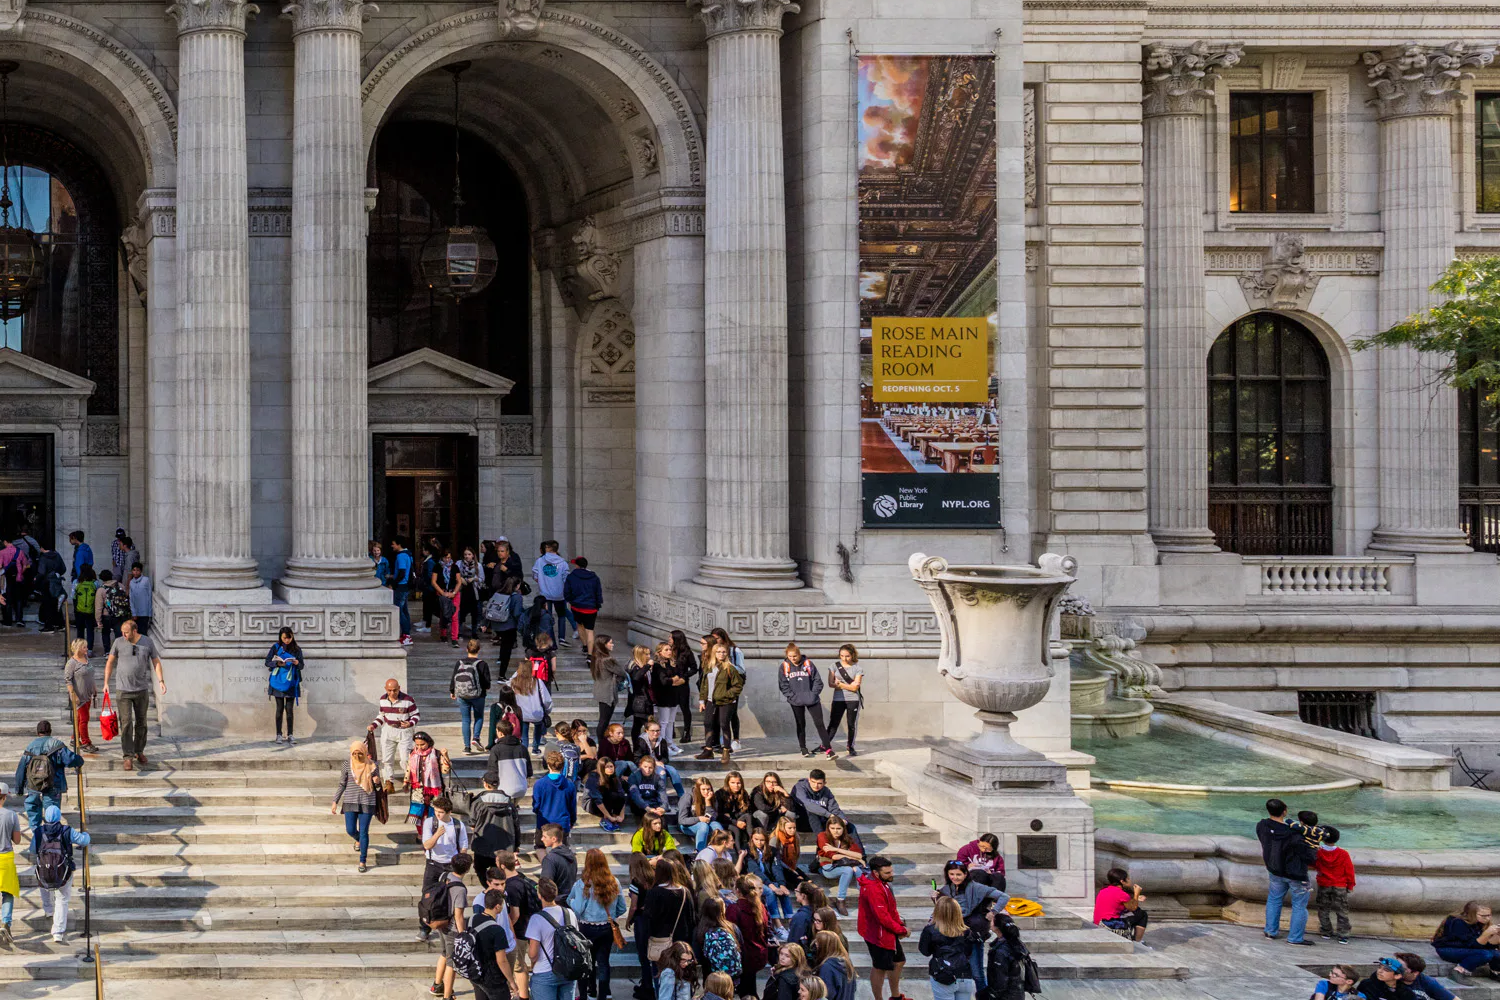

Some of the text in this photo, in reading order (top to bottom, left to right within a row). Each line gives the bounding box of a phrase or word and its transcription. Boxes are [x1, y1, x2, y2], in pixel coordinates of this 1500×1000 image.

[881, 326, 979, 341] ROSE MAIN
[881, 344, 962, 358] READING
[881, 362, 934, 376] ROOM
[882, 385, 960, 393] REOPENING OCT. 5
[899, 501, 924, 509] Library
[942, 500, 990, 508] NYPL.ORG
